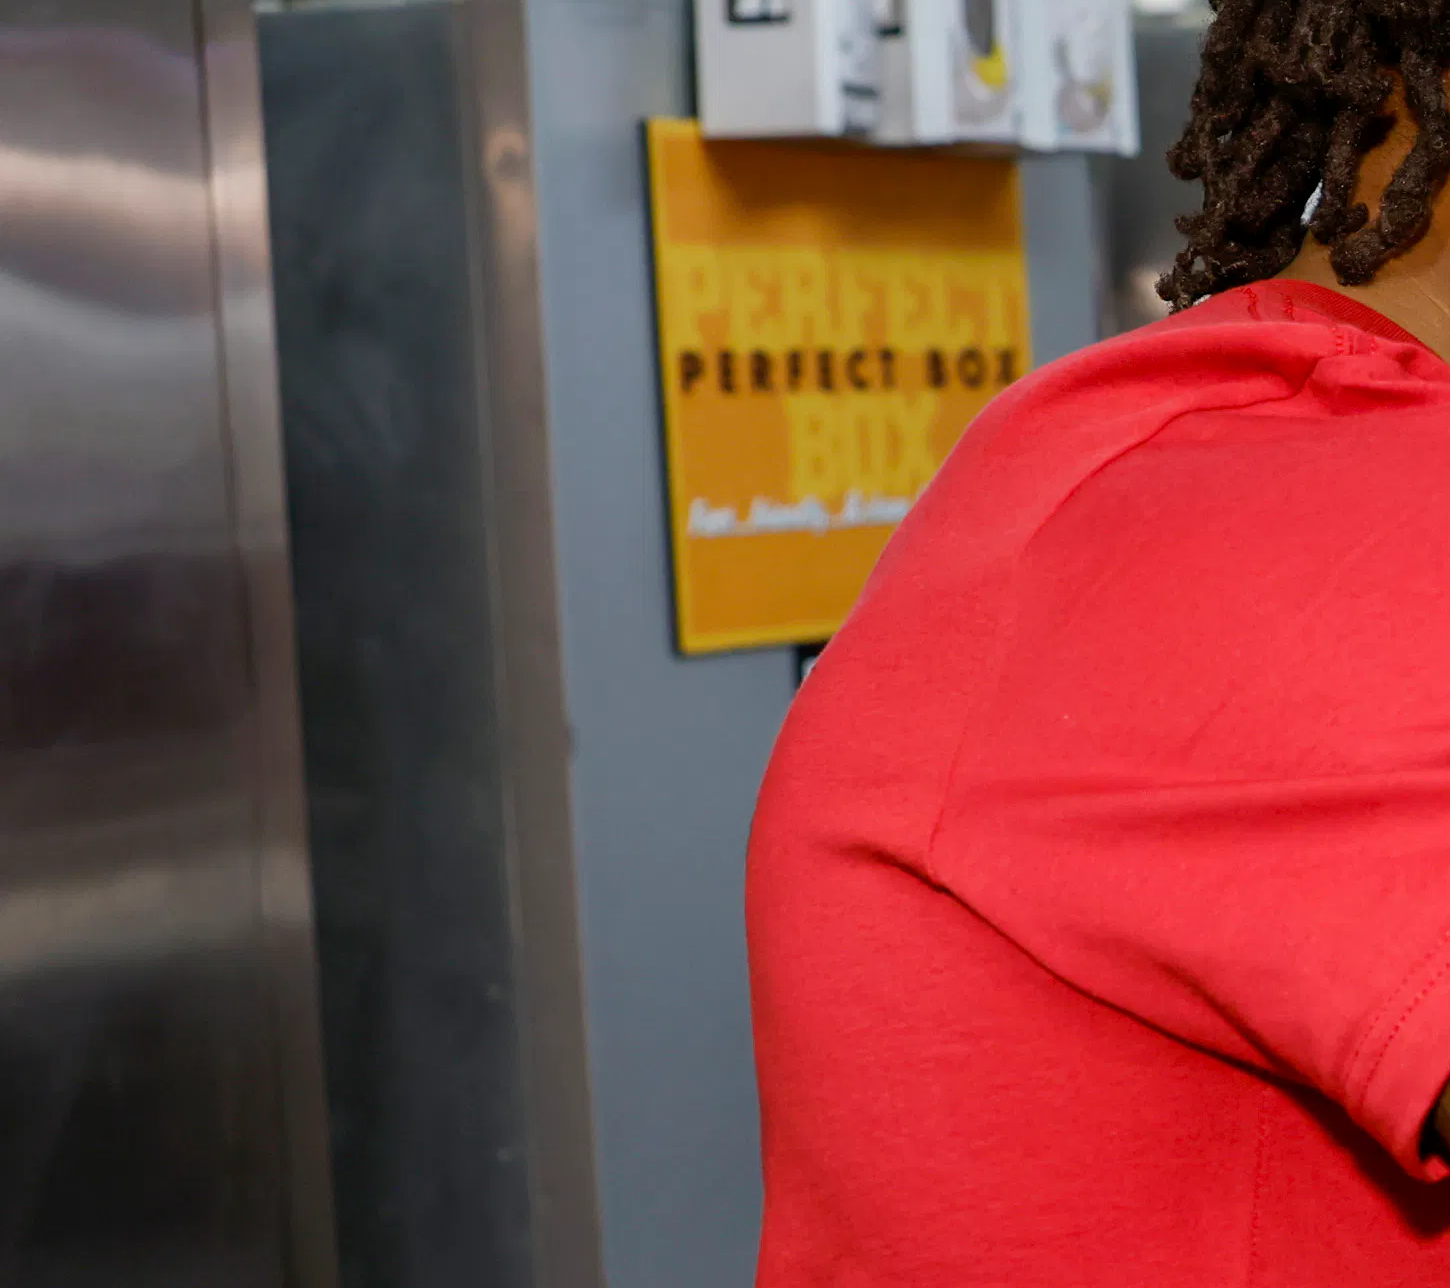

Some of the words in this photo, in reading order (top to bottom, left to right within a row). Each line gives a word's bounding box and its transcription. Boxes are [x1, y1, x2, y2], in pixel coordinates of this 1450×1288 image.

[675, 254, 1022, 351] PERFECT
[680, 345, 898, 393] PERFECT
[925, 345, 1020, 388] BOX
[788, 393, 936, 499] BOX
